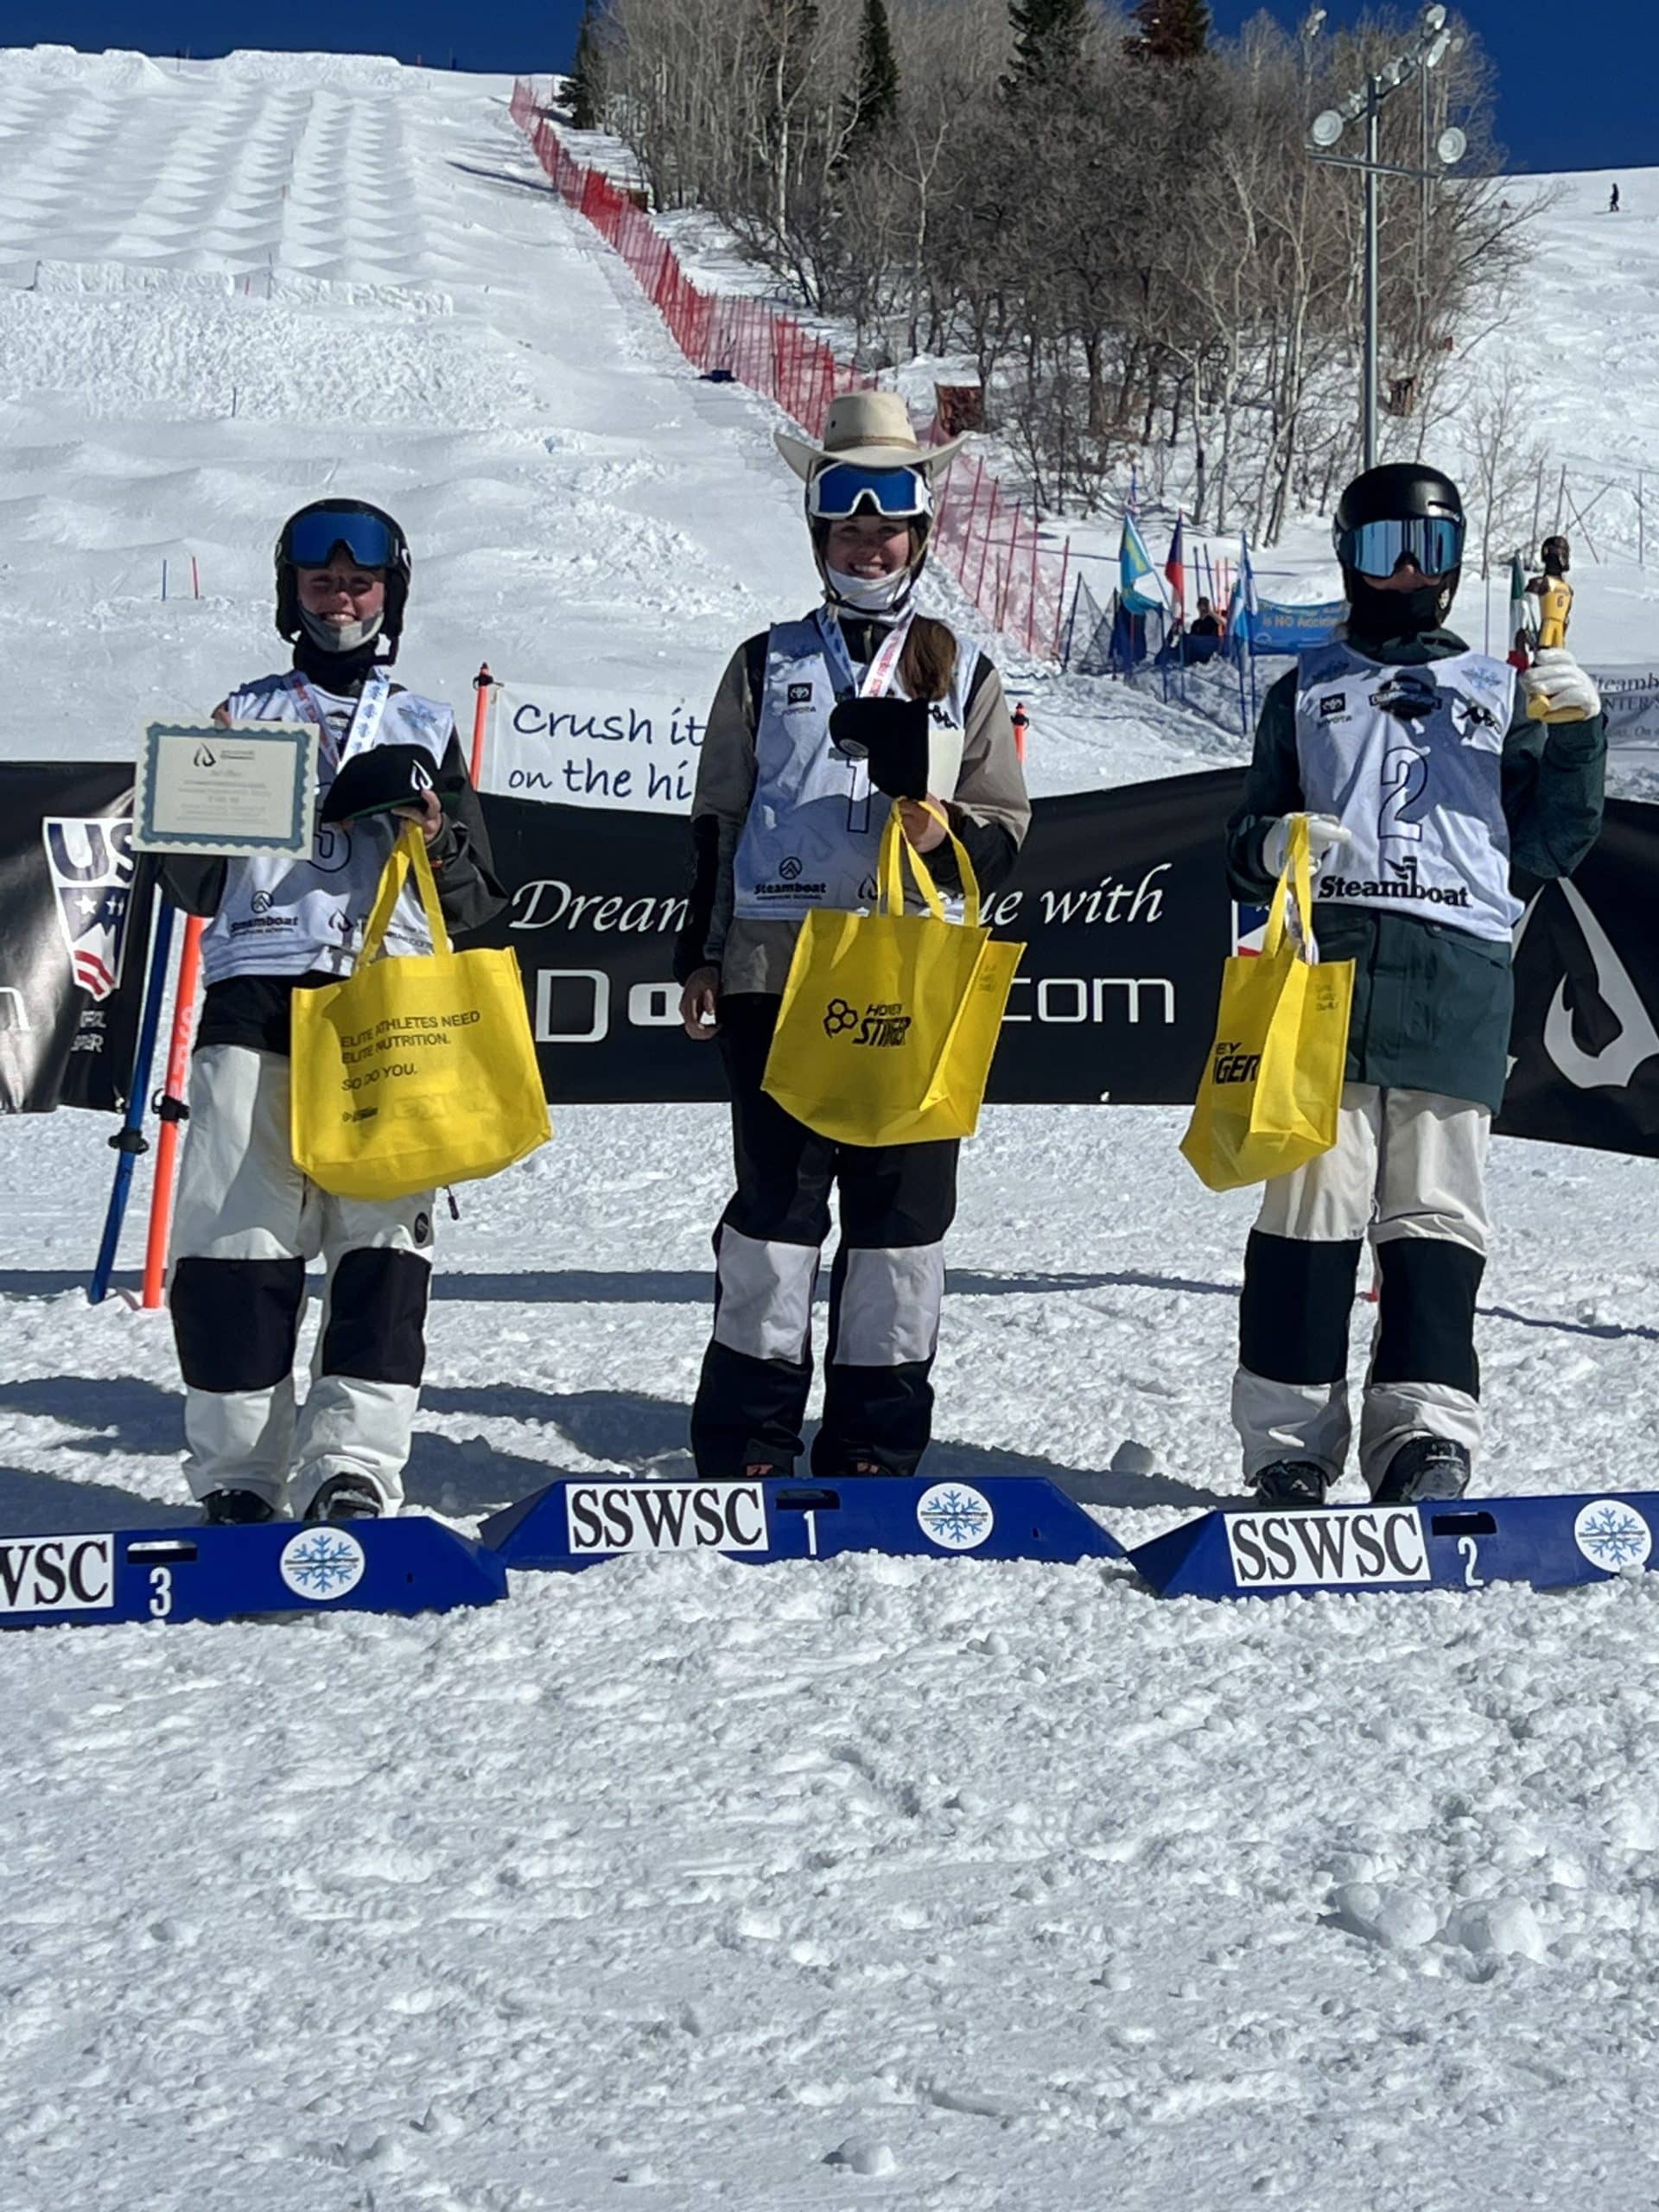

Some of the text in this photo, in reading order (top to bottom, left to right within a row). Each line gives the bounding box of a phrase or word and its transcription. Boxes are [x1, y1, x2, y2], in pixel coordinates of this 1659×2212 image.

[513, 703, 707, 747] Crush it
[508, 757, 693, 800] on the hi
[1377, 746, 1428, 842] 2
[1039, 862, 1173, 925] with
[1318, 861, 1473, 908] Steamboat
[340, 1010, 480, 1048] ELITE ATHLETES NEED
[340, 1044, 374, 1065] ELITE
[340, 1077, 363, 1091] SO
[571, 1487, 762, 1548] SSWSC
[803, 1510, 817, 1555] 1
[1231, 1513, 1423, 1581] SSWSC
[1458, 1535, 1484, 1586] 2
[149, 1567, 172, 1617] 3
